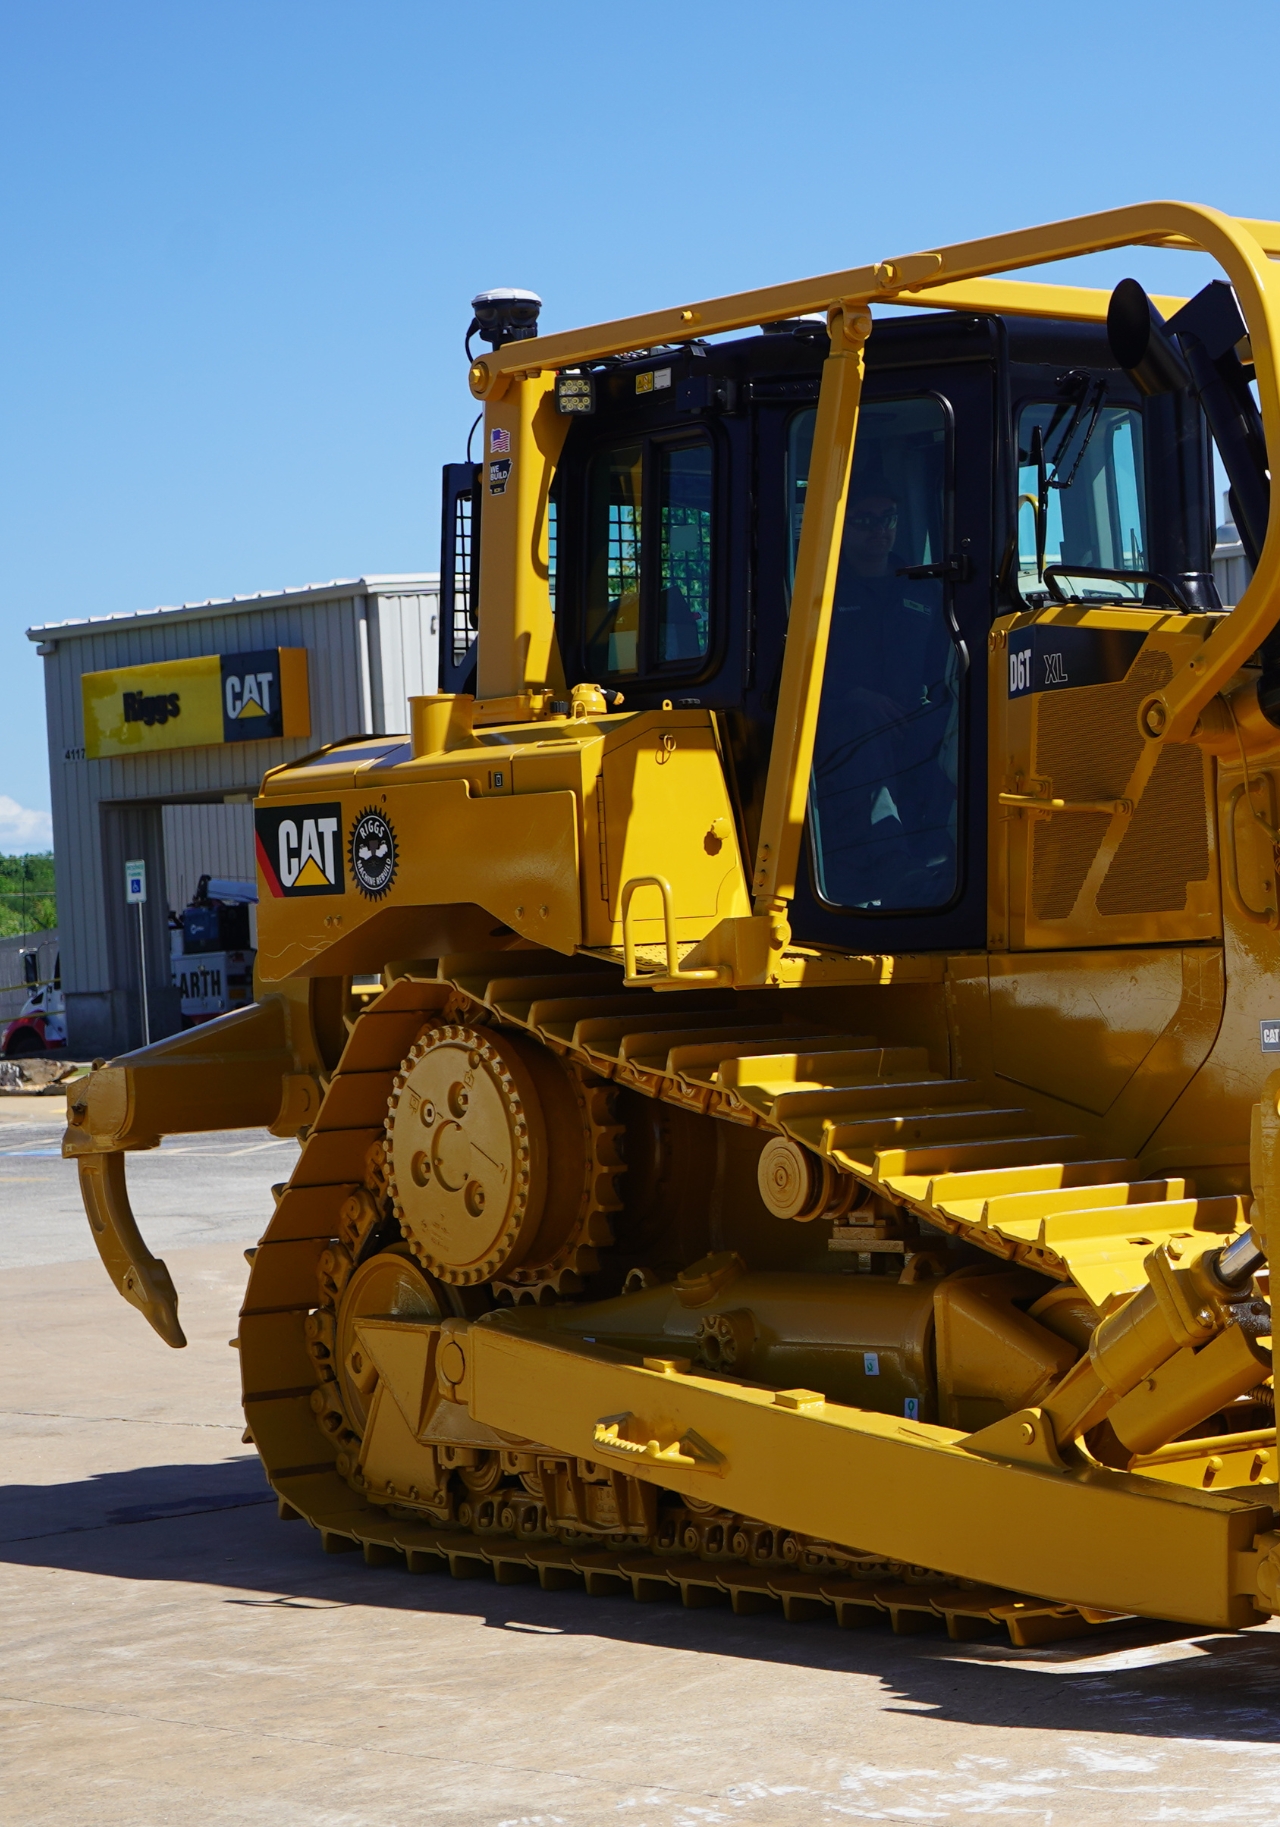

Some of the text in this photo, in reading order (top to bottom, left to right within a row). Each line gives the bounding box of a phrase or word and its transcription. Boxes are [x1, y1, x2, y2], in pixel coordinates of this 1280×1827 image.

[1010, 649, 1068, 692] D6T XL
[123, 672, 273, 726] Riggs CAT
[65, 748, 86, 759] 4117
[359, 820, 385, 839] RIGGS
[278, 817, 337, 887] CAT
[357, 858, 391, 886] MACHINE REBUILD
[1263, 1028, 1279, 1043] CAT
